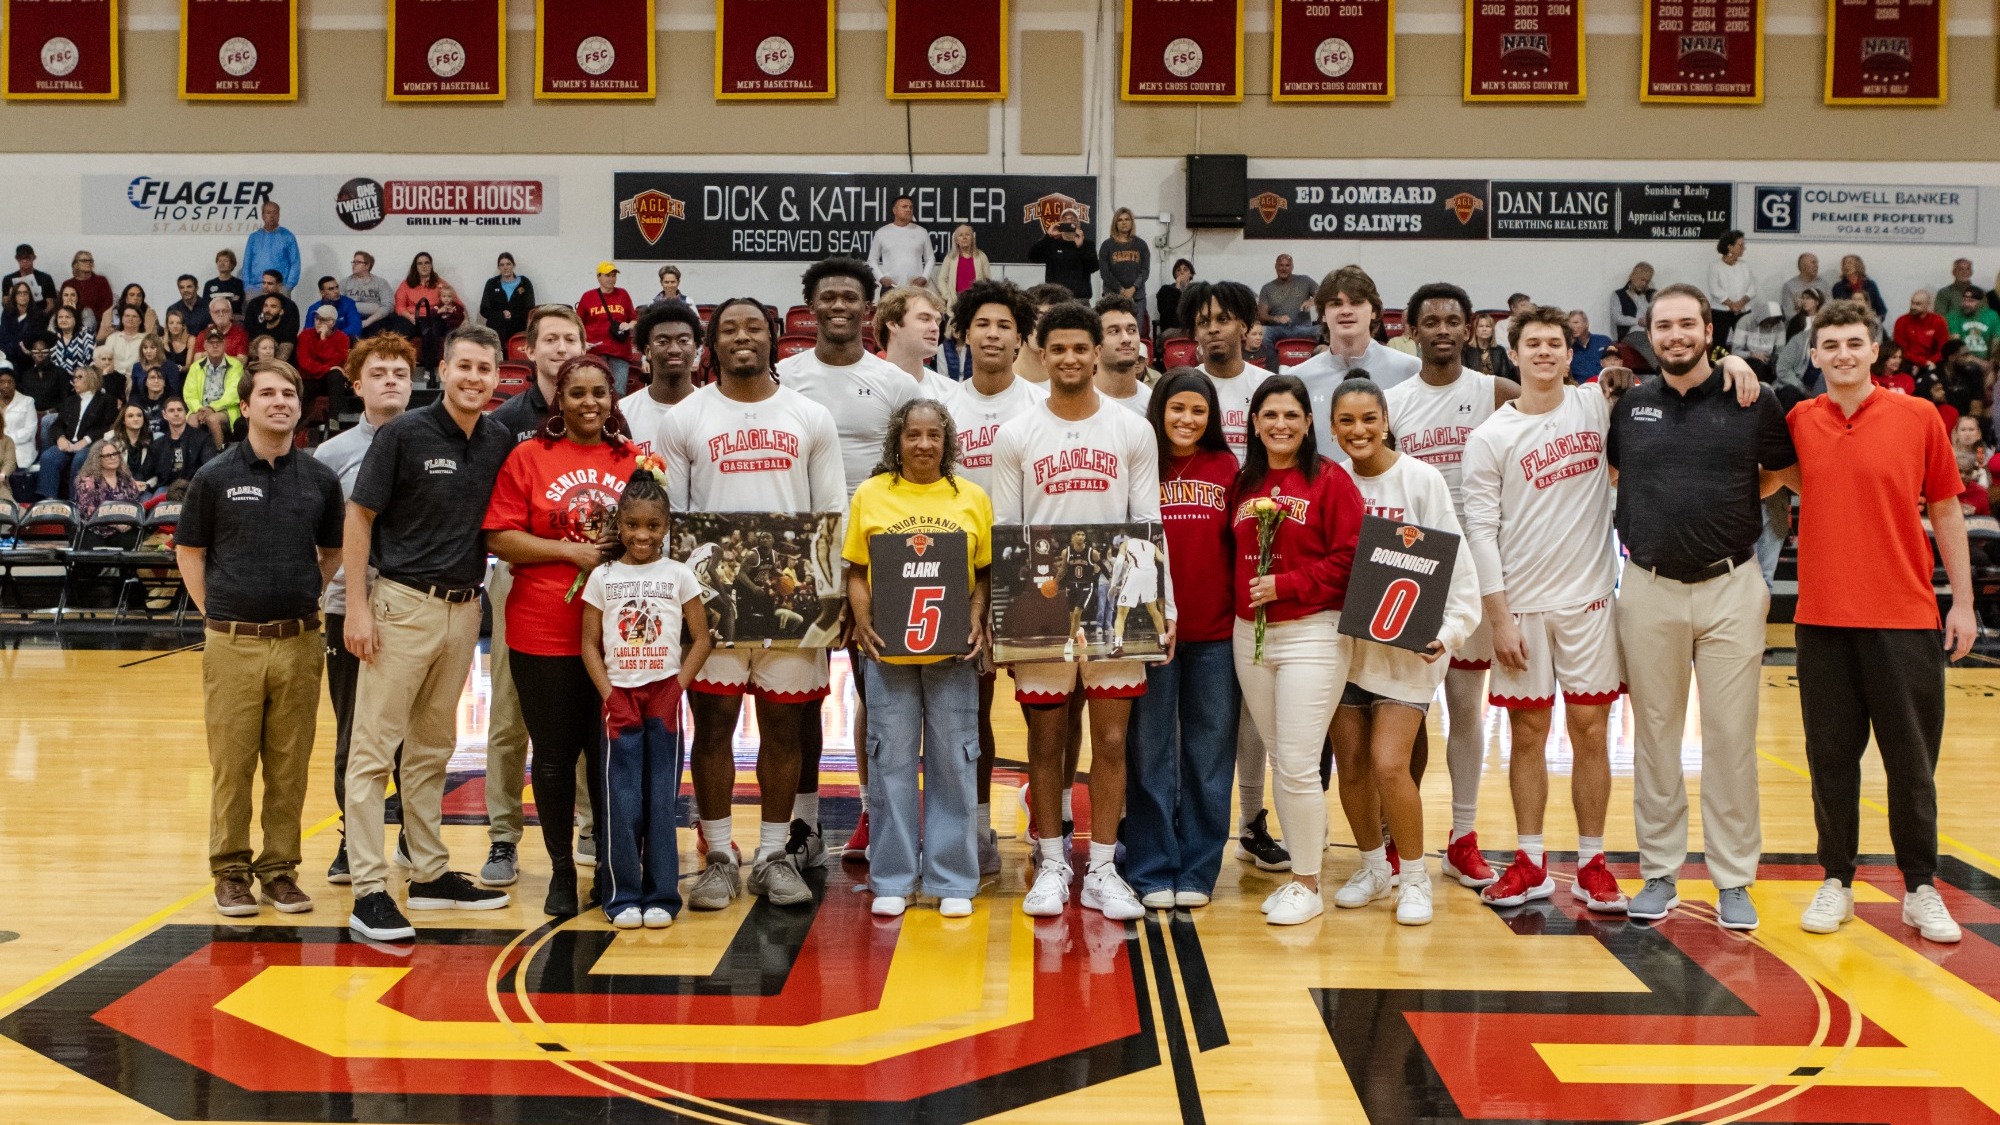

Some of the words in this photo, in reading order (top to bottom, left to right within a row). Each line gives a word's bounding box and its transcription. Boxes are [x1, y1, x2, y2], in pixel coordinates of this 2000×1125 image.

[1306, 5, 1330, 16] 2000
[1339, 5, 1363, 16] 2001
[1481, 4, 1506, 16] 2002
[1514, 5, 1539, 16] 2003
[1547, 5, 1571, 16] 2004
[1658, 5, 1684, 17] 2000
[1692, 6, 1716, 18] 2001
[1725, 6, 1750, 18] 2002
[1514, 19, 1539, 30] 2005
[1658, 19, 1684, 31] 2003
[1692, 20, 1716, 32] 2004
[1503, 35, 1549, 53] NAIA
[1680, 37, 1726, 55] NAIA
[49, 50, 72, 64] FSC
[227, 50, 250, 65] FSC
[436, 51, 459, 66] FSC
[585, 49, 608, 64] FSC
[764, 49, 787, 64] FSC
[936, 49, 959, 63] FSC
[1172, 51, 1196, 65] FSC
[1323, 51, 1347, 65] FSC
[35, 81, 84, 89] VOLLEYBALL
[216, 80, 240, 89] MEN'S
[242, 80, 261, 89] GOLF
[403, 82, 438, 91] WOMEN'S
[440, 81, 490, 91] BASKETBALL
[552, 80, 587, 89] WOMEN'S
[590, 80, 640, 89] BASKETBALL
[736, 80, 761, 89] MEN'S
[763, 80, 814, 89] BASKETBALL
[908, 80, 933, 89] MEN'S
[935, 79, 986, 88] BASKETBALL
[1139, 82, 1163, 90] MEN'S
[1165, 82, 1188, 90] CROSS
[1190, 82, 1226, 91] COUNTRY
[1284, 82, 1320, 90] WOMEN'S
[1321, 82, 1345, 90] CROSS
[1347, 82, 1383, 91] COUNTRY
[1481, 81, 1506, 90] MEN'S
[1507, 81, 1531, 90] CROSS
[1533, 81, 1569, 90] COUNTRY
[1652, 82, 1688, 92] WOMEN'S
[1690, 83, 1714, 92] CROSS
[1715, 83, 1751, 92] COUNTRY
[139, 181, 274, 205] FLAGLER
[356, 183, 376, 197] ONE
[1295, 186, 1325, 204] ED
[1330, 186, 1437, 204] LOMBARD
[1644, 185, 1682, 196] Sunshine
[1684, 185, 1710, 199] Realty
[336, 194, 378, 214] TWENTY
[391, 185, 468, 211] BURGER
[473, 185, 536, 211] HOUSE
[703, 185, 769, 221] DICK
[779, 186, 800, 222] &
[810, 186, 887, 222] KATHI
[1498, 191, 1543, 214] DAN
[1550, 191, 1609, 214] LANG
[1673, 198, 1681, 209] &
[1804, 190, 1890, 205] COLDWELL
[1896, 191, 1960, 206] BANKER
[154, 206, 259, 220] HOSPITA
[620, 197, 685, 219] FLAGLER
[351, 209, 381, 224] THREE
[641, 214, 664, 224] Saints
[1309, 214, 1338, 232] GO
[1344, 214, 1422, 232] SAINTS
[1628, 211, 1667, 225] Appraisal
[1668, 211, 1705, 223] Services,
[1707, 211, 1726, 222] LLC
[1812, 212, 1870, 223] PREMIER
[1873, 212, 1954, 224] PROPERTIES
[178, 222, 262, 233] AUGUSTIN
[1498, 220, 1553, 230] EVERYTHING
[1554, 220, 1577, 230] REAL
[1578, 220, 1609, 230] ESTATE
[1651, 226, 1702, 237] 904.501.6867
[732, 229, 822, 252] RESERVED
[828, 230, 873, 253] SEATI
[1631, 406, 1663, 419] FLAGLER
[708, 428, 799, 463] FLAGLER
[1401, 426, 1474, 454] FLAGLE
[1520, 431, 1603, 481] FLAGLER
[424, 458, 458, 470] FLAGLER
[723, 458, 788, 472] BASKETBALL
[1033, 447, 1118, 486] FLAGLER
[1538, 459, 1597, 488] BASKETBALL
[545, 468, 598, 502] SENIOR
[601, 472, 627, 494] MO
[227, 486, 264, 499] FLAGLER
[1160, 479, 1225, 512] AINTS
[1369, 547, 1440, 576] BOUKNIGHT
[902, 561, 941, 579] CLARK
[605, 581, 641, 600] DESTIN
[642, 581, 674, 600] CLARK
[1369, 578, 1421, 642] 0
[904, 586, 946, 653] 5
[614, 646, 640, 658] FLAGLER
[642, 646, 668, 657] COLLEGE
[619, 659, 637, 670] CLASS
[639, 659, 647, 669] OF
[649, 659, 664, 670] 2025
